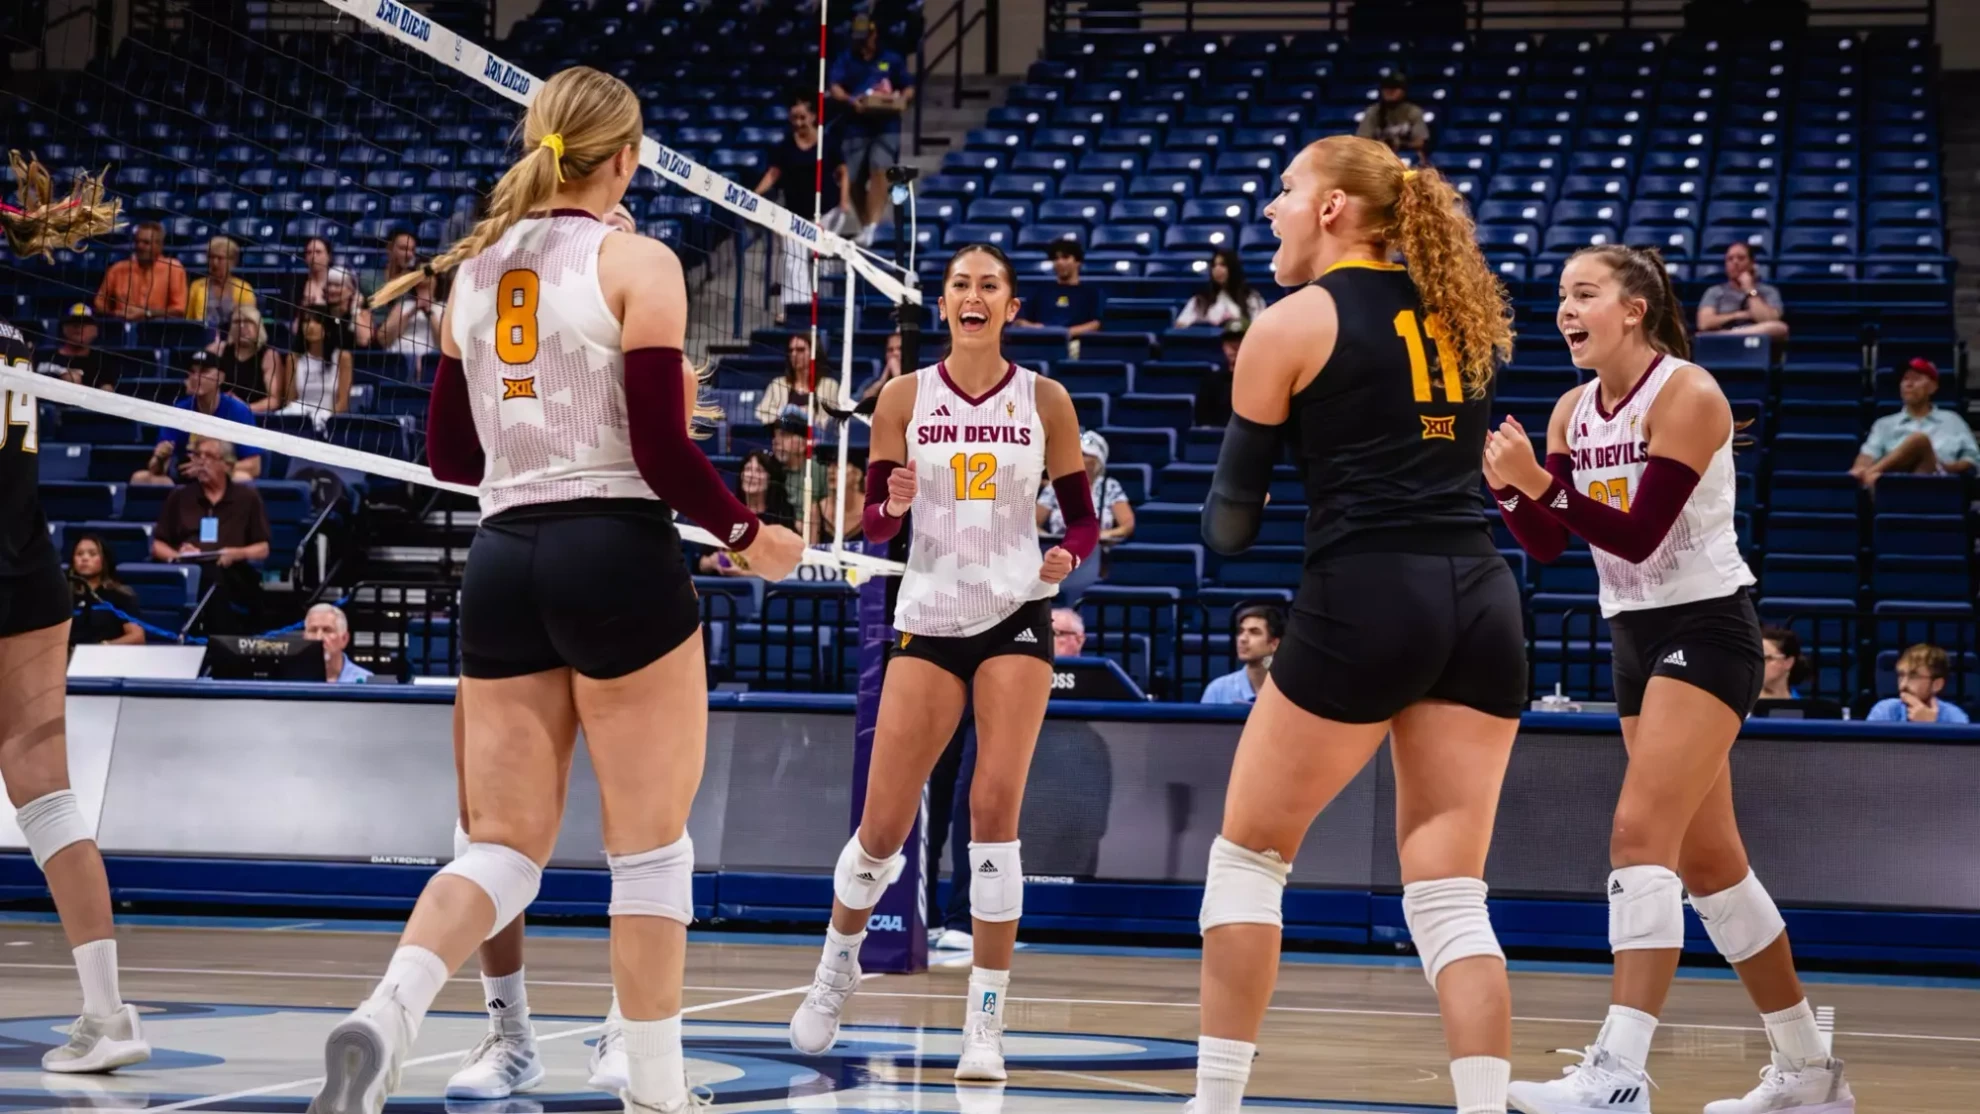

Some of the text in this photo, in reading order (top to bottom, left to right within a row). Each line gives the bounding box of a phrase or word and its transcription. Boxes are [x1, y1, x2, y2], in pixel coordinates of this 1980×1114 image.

[376, 0, 431, 42] SAN DIEGO
[484, 54, 530, 95] SAN DIEGO
[495, 268, 540, 365] 8
[1393, 309, 1464, 403] 11
[917, 425, 1031, 446] SUN DEVILS
[1420, 415, 1456, 441] XII
[1595, 441, 1649, 468] DEVILS
[950, 452, 998, 501] 12
[371, 855, 437, 865] DAKTRONICS
